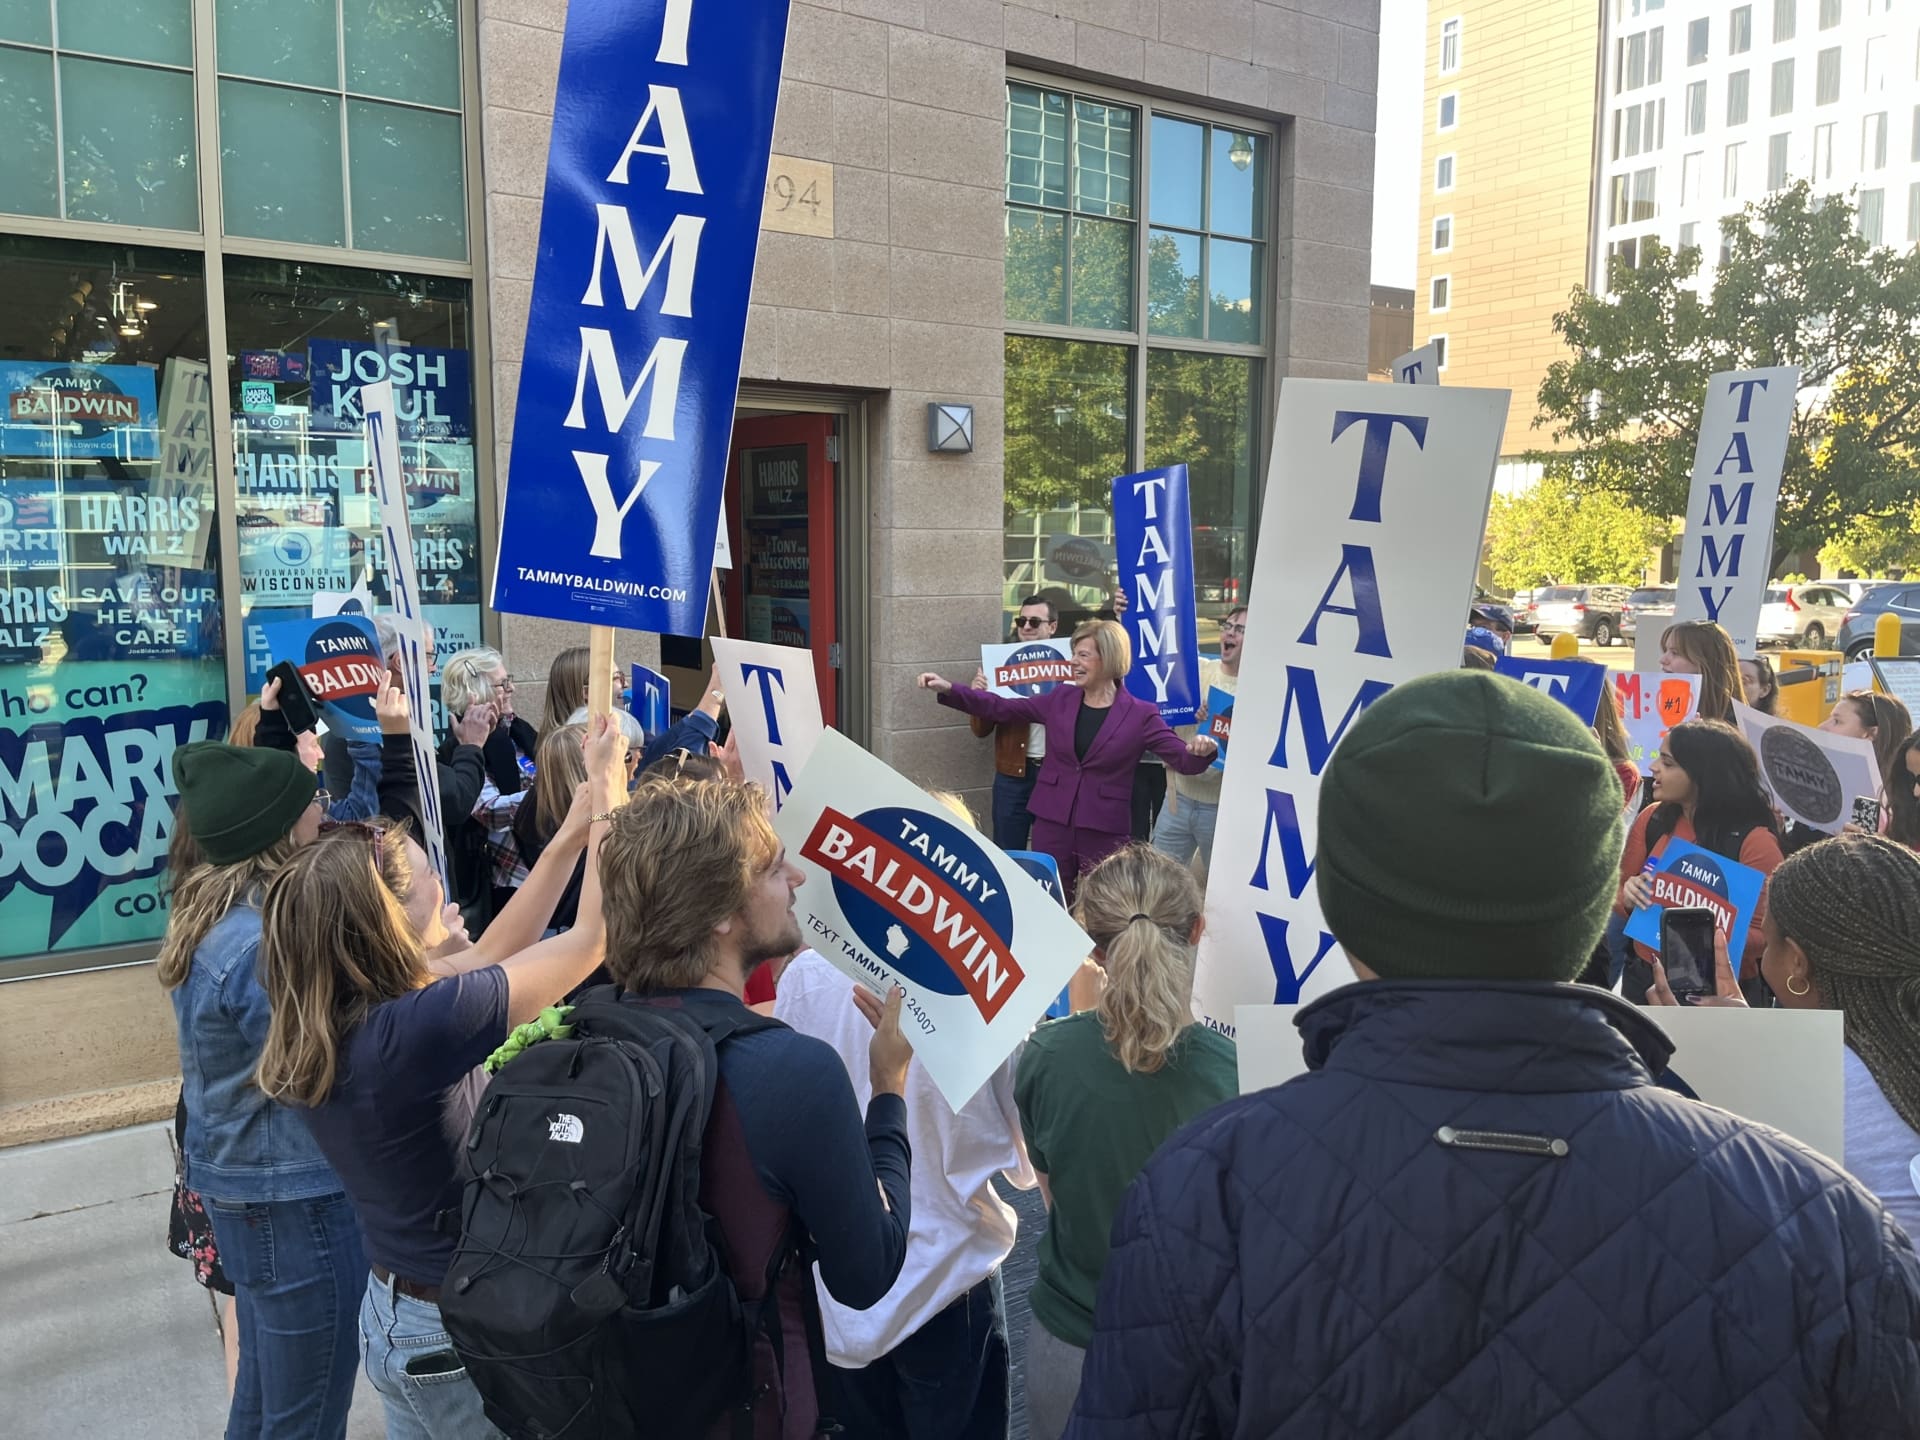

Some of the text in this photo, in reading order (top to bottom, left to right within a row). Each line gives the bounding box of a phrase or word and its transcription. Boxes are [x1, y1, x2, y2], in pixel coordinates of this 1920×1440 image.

[767, 174, 821, 217] 94
[331, 349, 447, 388] JOSH
[44, 376, 103, 390] TAMMY
[16, 396, 134, 418] BALDWIN
[332, 384, 450, 423] KUL
[237, 453, 339, 489] HARRIS
[360, 471, 455, 490] BDWIN
[758, 460, 799, 487] HARRIS
[768, 488, 793, 503] WALZ
[1695, 379, 1768, 623] TAMMY
[80, 495, 200, 532] HARRIS
[103, 536, 184, 555] WALZ
[364, 537, 463, 571] HRIS
[243, 576, 346, 591] WISCONSIN
[258, 568, 329, 577] FORWARD FOR
[517, 567, 687, 602] TAMMYBALDWIN.COM
[81, 588, 217, 603] SAVE OUR
[1133, 477, 1178, 703] TAMMY
[97, 608, 203, 624] HEALTH
[115, 630, 187, 645] CARE
[316, 636, 369, 653] TAMMY
[771, 629, 805, 646] LDWIN
[1016, 650, 1052, 661] TAMMY
[999, 664, 1073, 683] BALDWIN
[65, 674, 148, 709] can?
[899, 818, 998, 904] TAMMY
[1681, 860, 1720, 887] TAMMY
[817, 823, 1009, 1002] BALDWIN
[1654, 878, 1732, 933] BALDWIN
[807, 913, 840, 944] TEXT
[841, 940, 890, 982] TAMMY
[907, 998, 937, 1036] 24007
